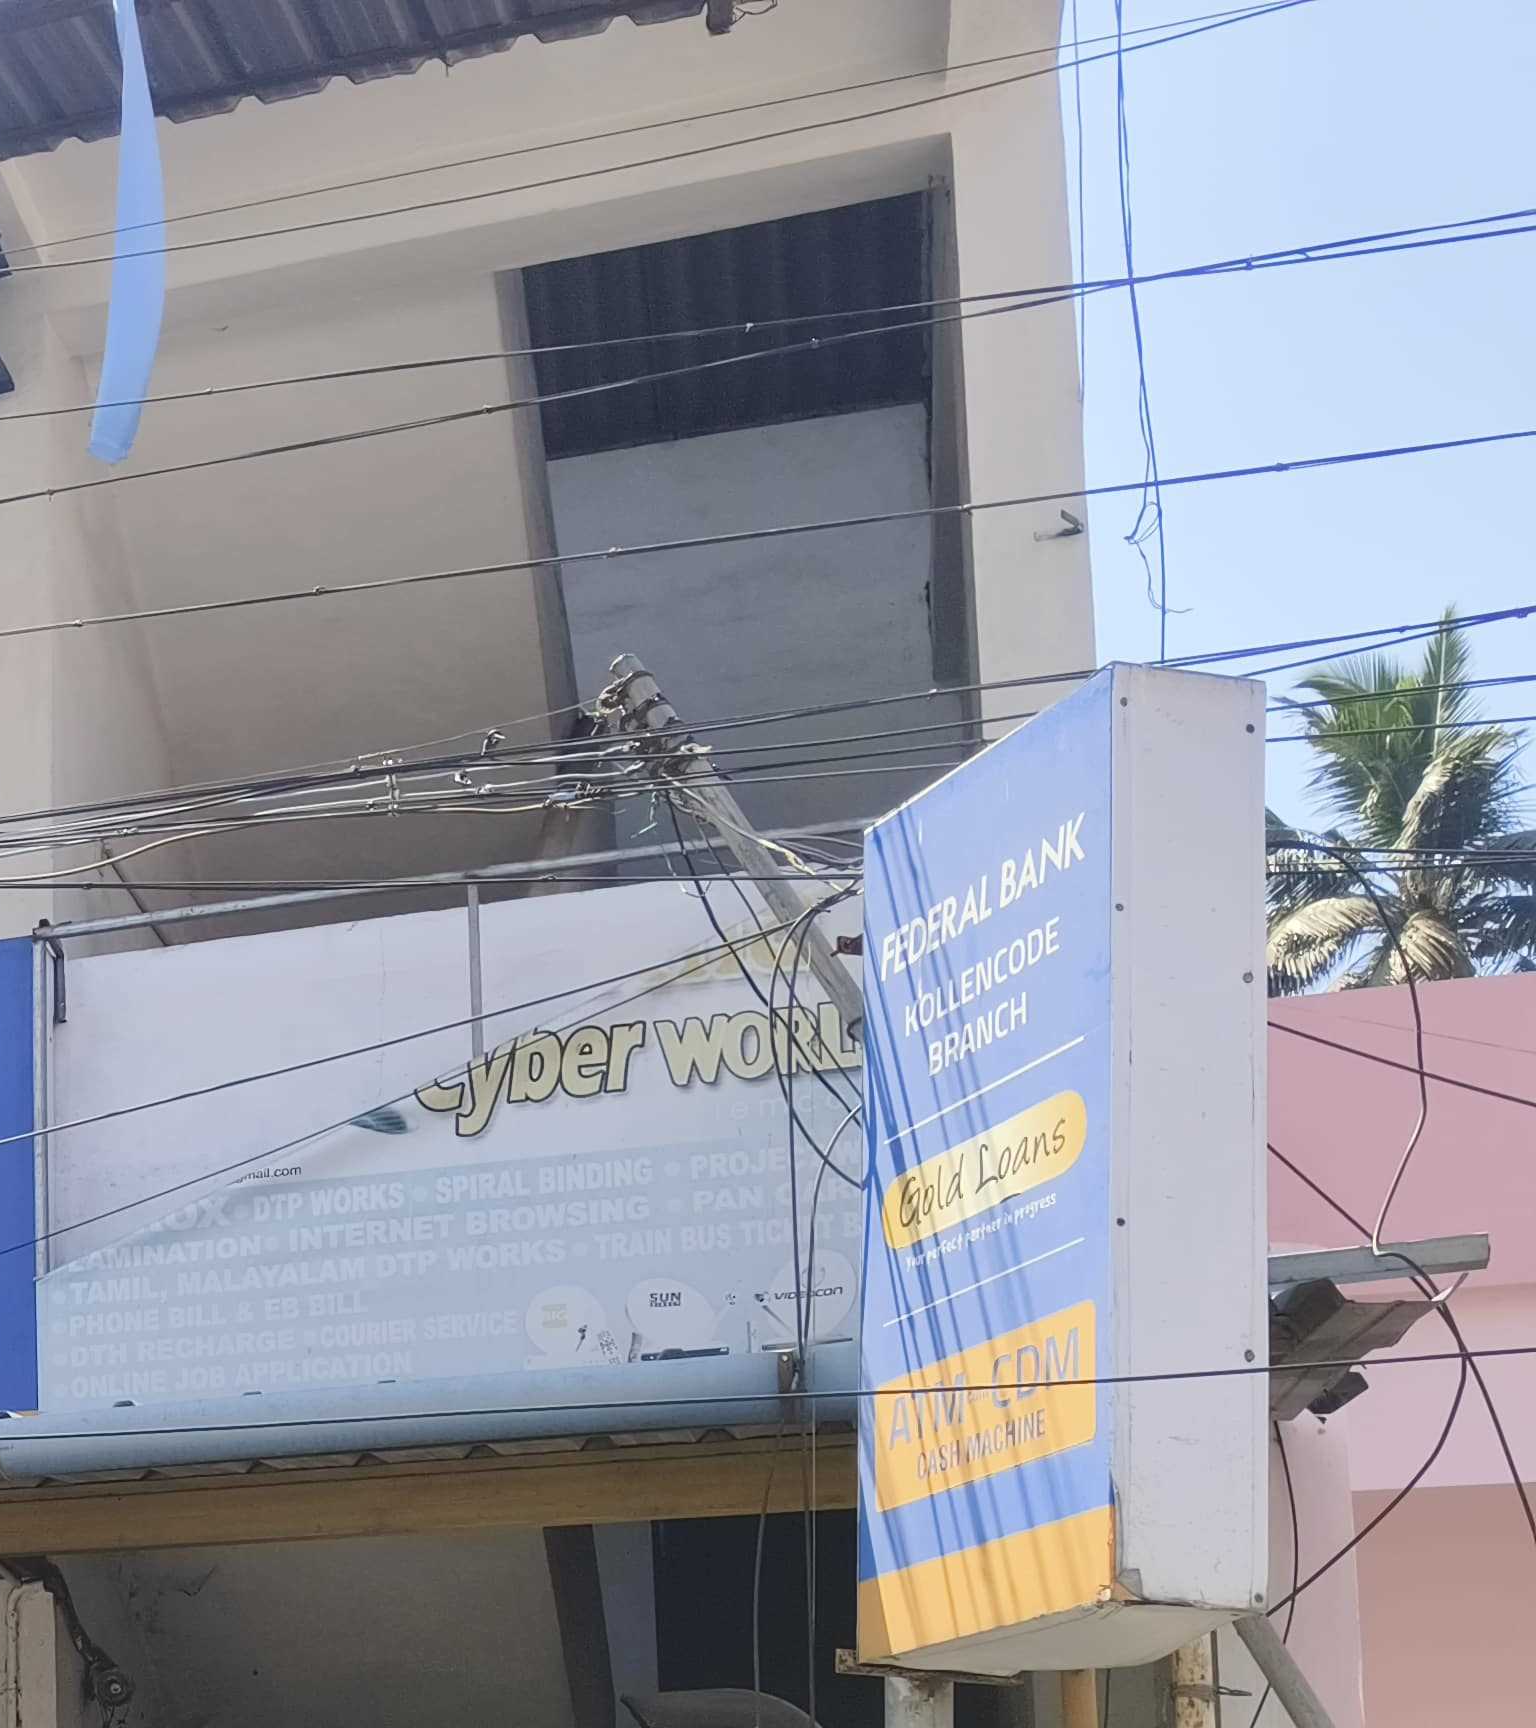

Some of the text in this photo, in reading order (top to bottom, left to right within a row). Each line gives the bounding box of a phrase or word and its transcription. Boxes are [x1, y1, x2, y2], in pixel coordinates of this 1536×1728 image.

[880, 875, 993, 981] FEDERAL
[1000, 812, 1086, 909] BANK
[904, 916, 1061, 1038] KOLLENCODE
[654, 1002, 863, 1086] WORL
[928, 991, 1027, 1078] BRANCH
[239, 1165, 303, 1185] mail.com
[253, 1192, 303, 1223] DTP
[312, 1182, 405, 1216] WORKS
[435, 1169, 529, 1204] SPIRAL
[538, 1155, 654, 1192] BINDING
[899, 1118, 1066, 1228] Gold Loans
[289, 1213, 455, 1251] INTERNET
[465, 1197, 650, 1236] BROWSING
[693, 1183, 762, 1214] PAN
[177, 1254, 367, 1297] MALAYALAM
[376, 1249, 438, 1279] DTP
[446, 1237, 566, 1272] WORKS
[593, 1228, 673, 1261] TRAIN
[680, 1221, 734, 1252] BUS
[70, 1308, 161, 1337] PHONE
[168, 1304, 227, 1330] BILL
[309, 1290, 369, 1315] BILL
[649, 1292, 681, 1301] SUN
[70, 1309, 521, 1369] DTH RECHARGE COURIER SERVICE
[70, 1351, 414, 1400] ONLINE JOB APPLICATION
[890, 1370, 968, 1450] ATM
[992, 1327, 1079, 1409] CDM
[917, 1408, 1046, 1480] CASH MACHINE
